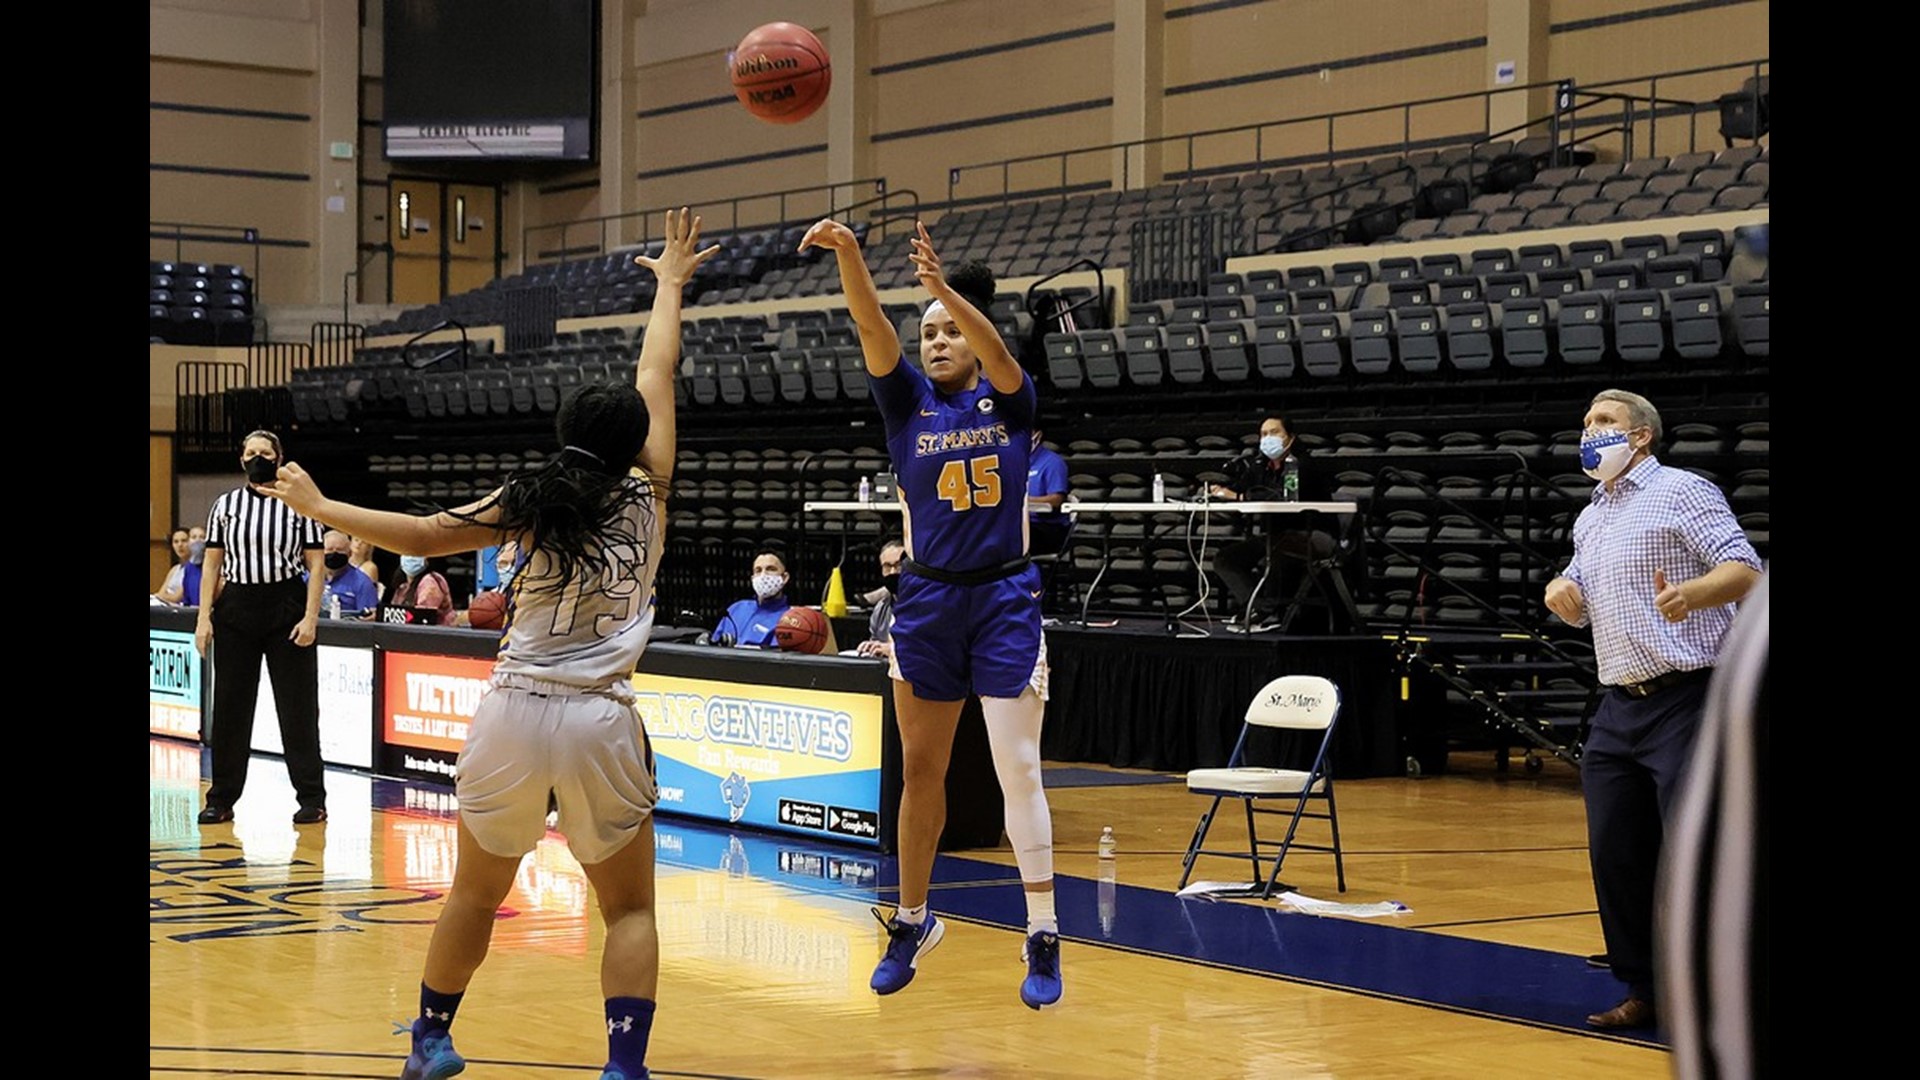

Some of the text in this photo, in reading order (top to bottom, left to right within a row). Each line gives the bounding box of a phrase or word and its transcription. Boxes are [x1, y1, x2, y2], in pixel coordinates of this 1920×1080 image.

[736, 54, 798, 77] Wilson
[748, 83, 796, 104] NCAA
[474, 125, 532, 137] ELECTRIC
[936, 454, 1002, 512] 45
[384, 607, 406, 624] POSS
[698, 746, 780, 773] Fan Rewards
[791, 811, 822, 826] App Store
[841, 818, 876, 836] Google Play
